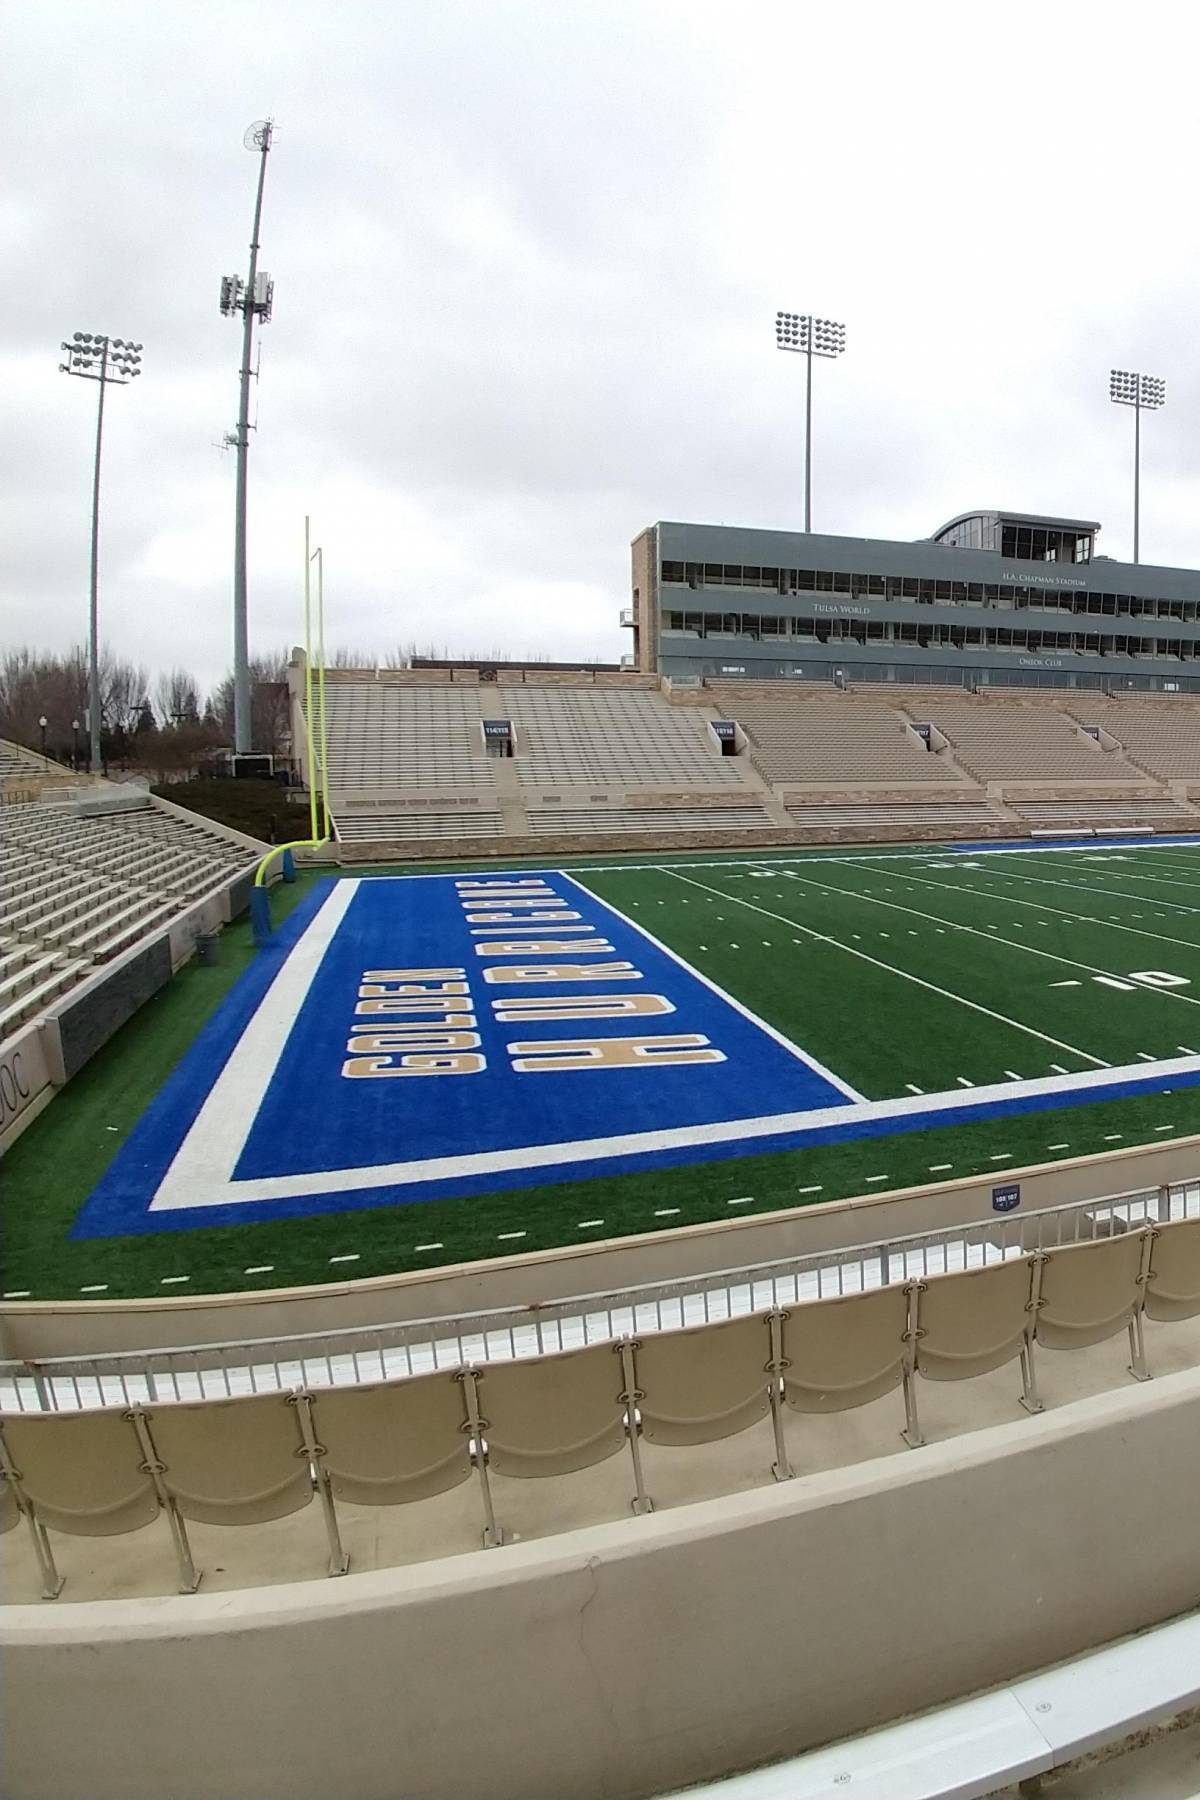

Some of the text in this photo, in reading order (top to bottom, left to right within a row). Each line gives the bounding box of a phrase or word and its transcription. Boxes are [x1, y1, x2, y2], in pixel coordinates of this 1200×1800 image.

[812, 603, 870, 615] TULSA WORLD
[454, 878, 729, 1073] HURRICANE
[1090, 960, 1192, 990] 10
[341, 967, 488, 1079] GOLDEN
